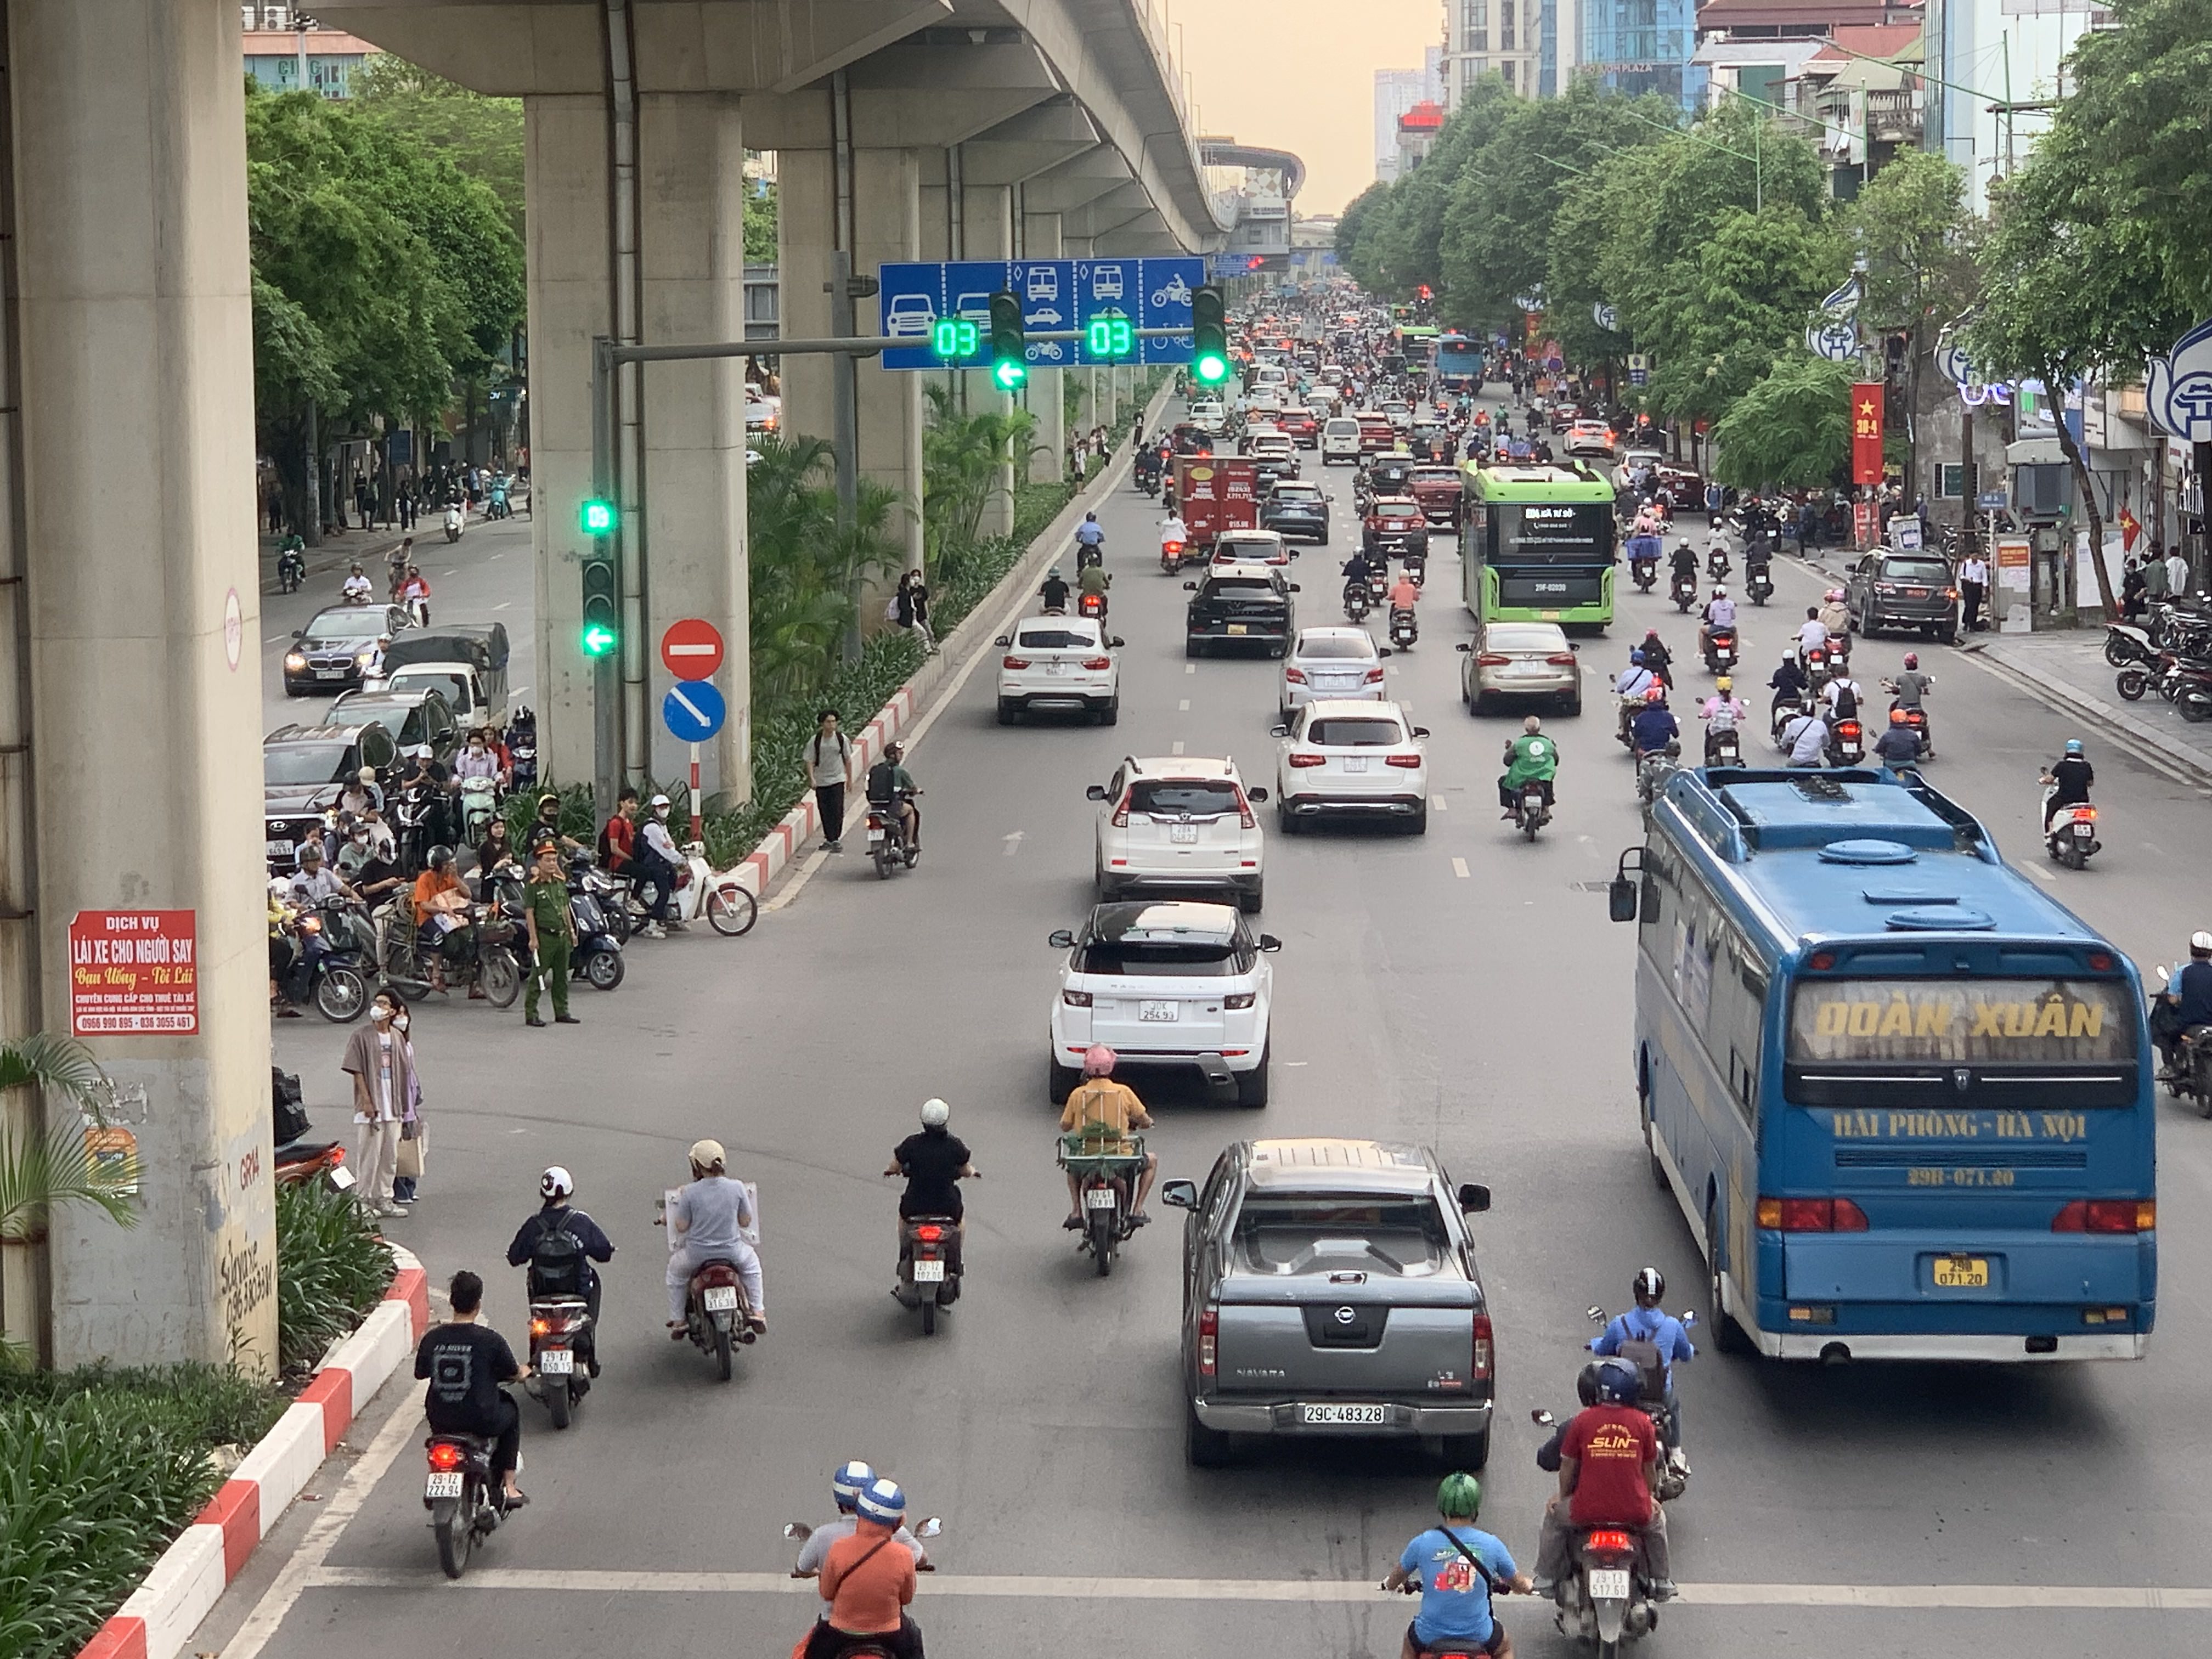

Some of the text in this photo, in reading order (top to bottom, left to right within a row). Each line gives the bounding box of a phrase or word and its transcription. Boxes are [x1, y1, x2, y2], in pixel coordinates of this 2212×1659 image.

[1622, 63, 1652, 72] PLAZA
[937, 323, 976, 356] 03
[1091, 321, 1130, 354] 03
[1857, 420, 1877, 433] 30-4
[106, 916, 159, 932] DỊCH VỤ
[74, 933, 193, 964] LÁI XE CHO NGƯỜI SAY
[75, 967, 101, 988] Bạn
[104, 966, 137, 991] Uống
[152, 966, 171, 984] Tôi
[174, 966, 194, 984] Lái
[75, 992, 103, 1003] CHUYÊN
[104, 994, 123, 1003] CUNG
[124, 991, 138, 1003] CẤP
[139, 994, 154, 1003] CHO
[173, 991, 184, 1003] TÀI
[103, 1018, 117, 1028] 990
[119, 1017, 133, 1028] 895
[156, 1017, 175, 1028] 3055
[1970, 993, 2105, 1036] XUÂN
[1889, 1110, 1977, 1137] PHÒNG
[1996, 1110, 2033, 1137] HÀ
[2042, 1110, 2086, 1143] NỘI
[1940, 1274, 1982, 1285] 071.20
[1589, 1436, 1635, 1448] SLIN
